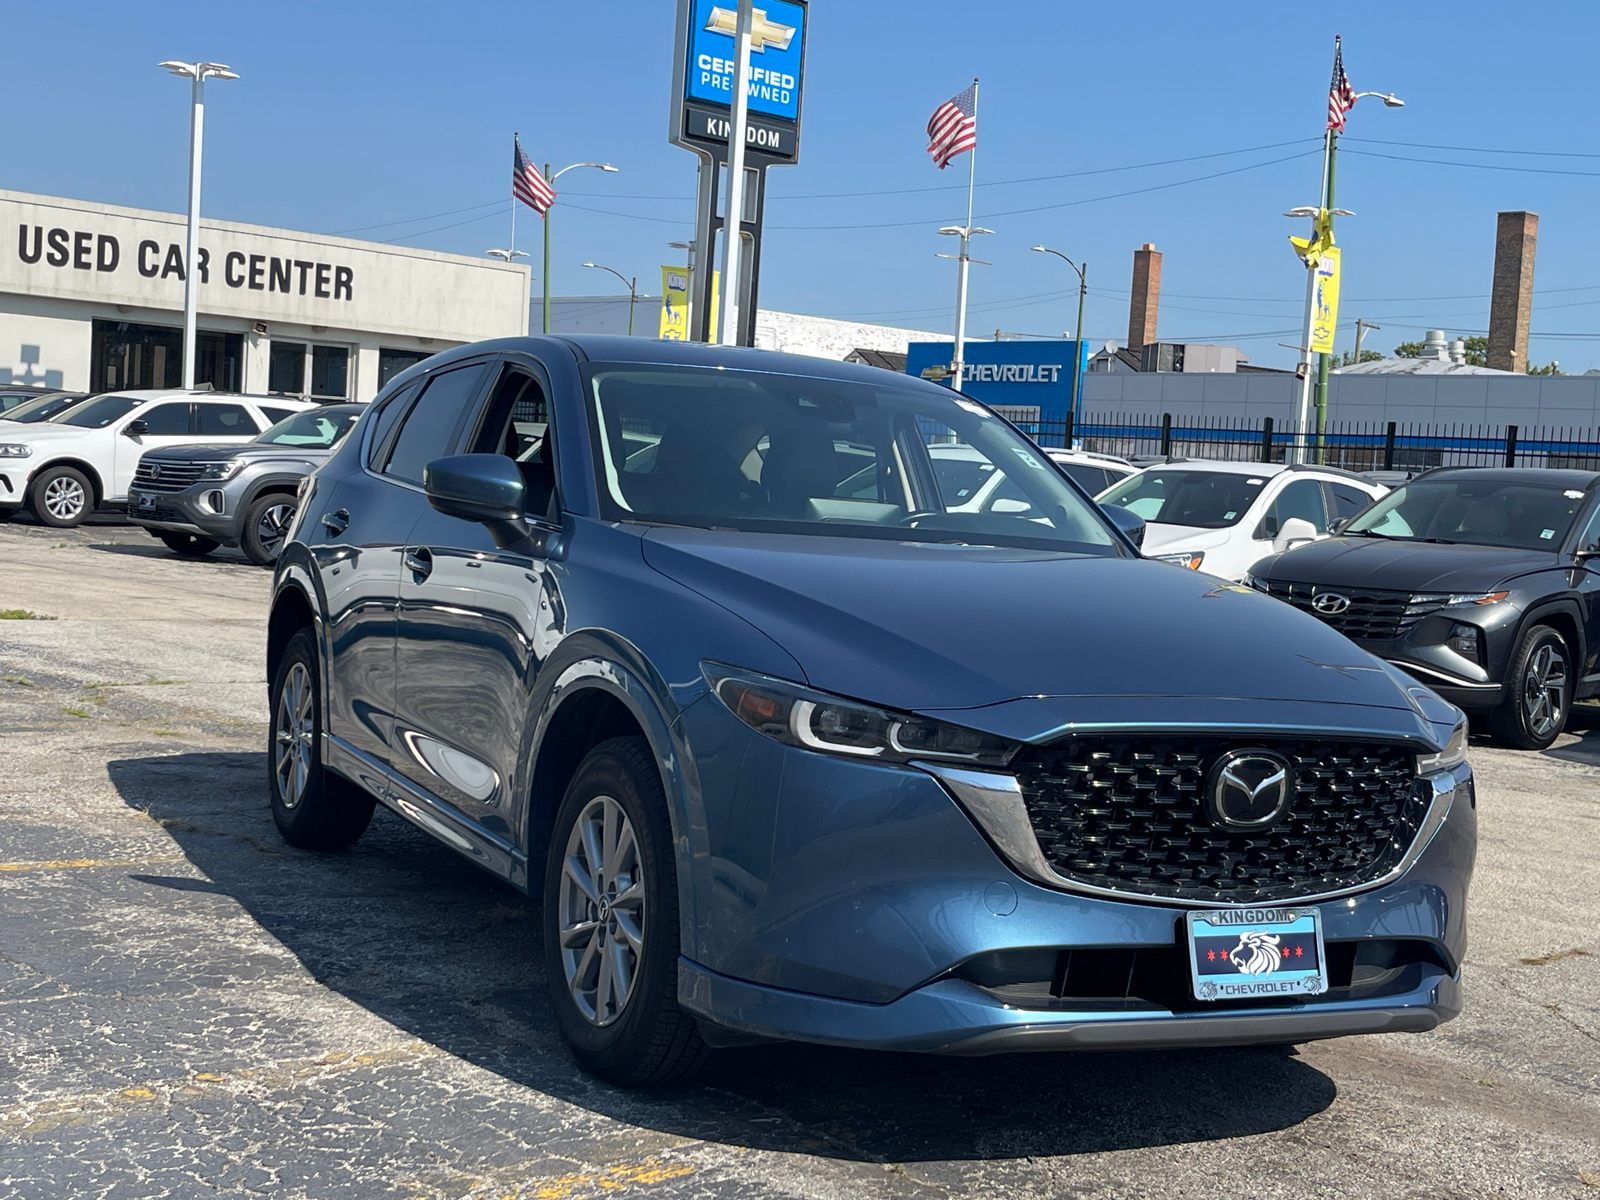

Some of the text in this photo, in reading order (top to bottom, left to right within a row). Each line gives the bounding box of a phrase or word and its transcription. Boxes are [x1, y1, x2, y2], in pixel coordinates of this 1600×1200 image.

[698, 54, 795, 90] CERIFIED
[701, 71, 790, 104] PRE-WNED
[707, 117, 780, 148] KINDOM
[18, 223, 354, 301] USED CAR CENTER
[667, 272, 687, 291] King
[1218, 909, 1289, 924] KINGDOM
[1225, 981, 1296, 995] CHEVROLET
